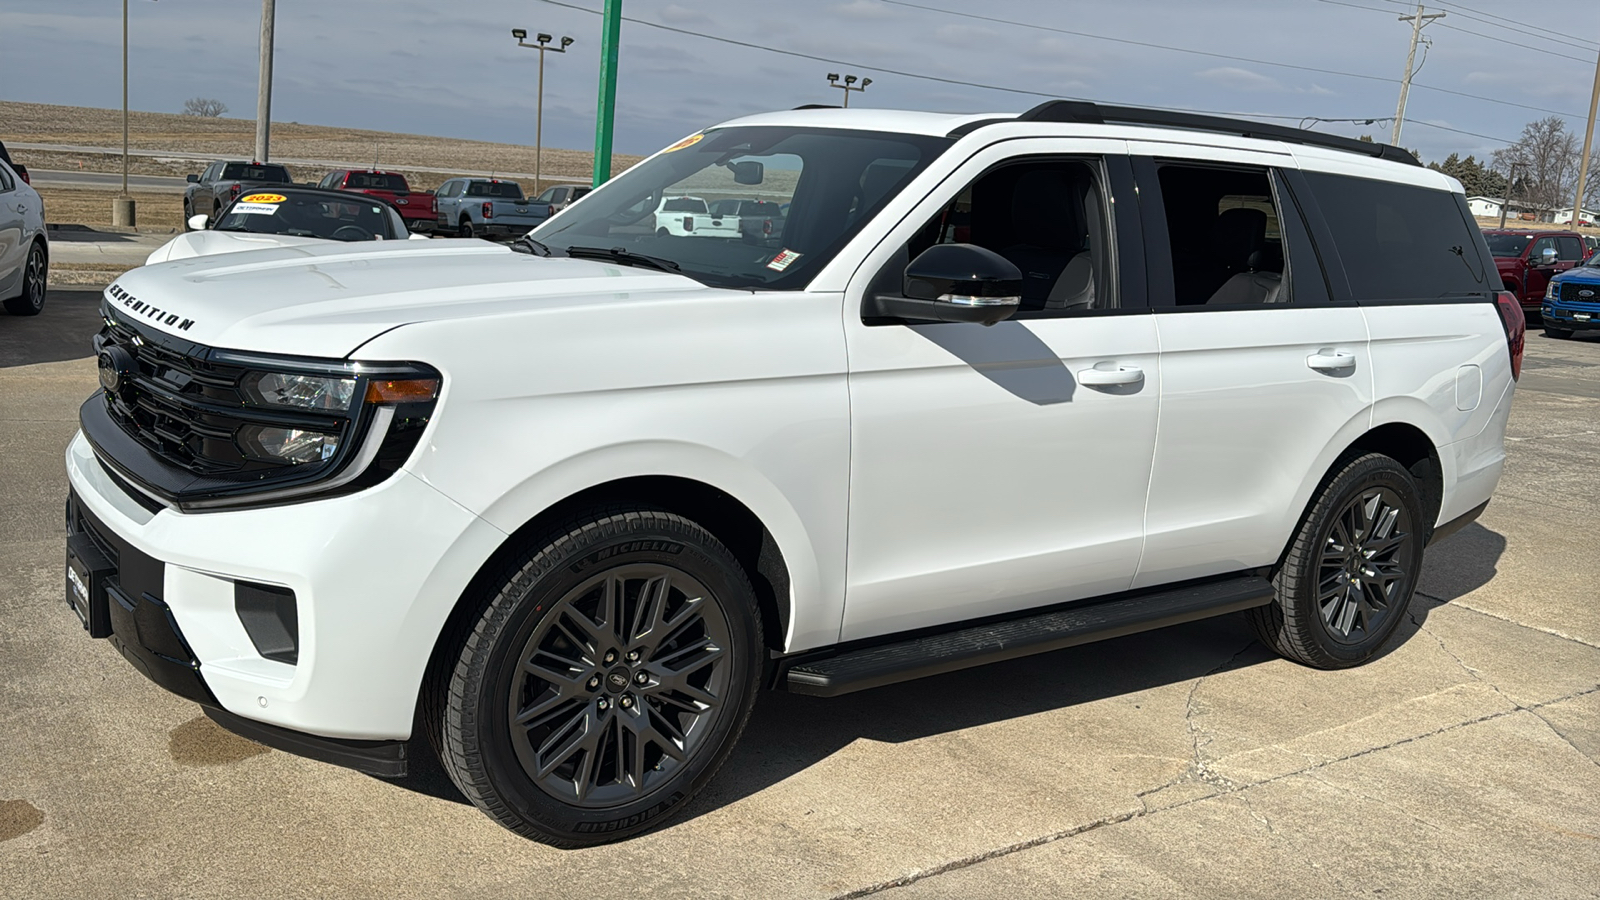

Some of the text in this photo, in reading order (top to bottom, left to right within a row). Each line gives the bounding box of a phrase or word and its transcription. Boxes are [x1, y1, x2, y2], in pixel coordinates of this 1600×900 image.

[109, 284, 195, 331] EXPEDITION
[597, 541, 681, 561] MICHELIN
[577, 804, 660, 832] MICHELIN
